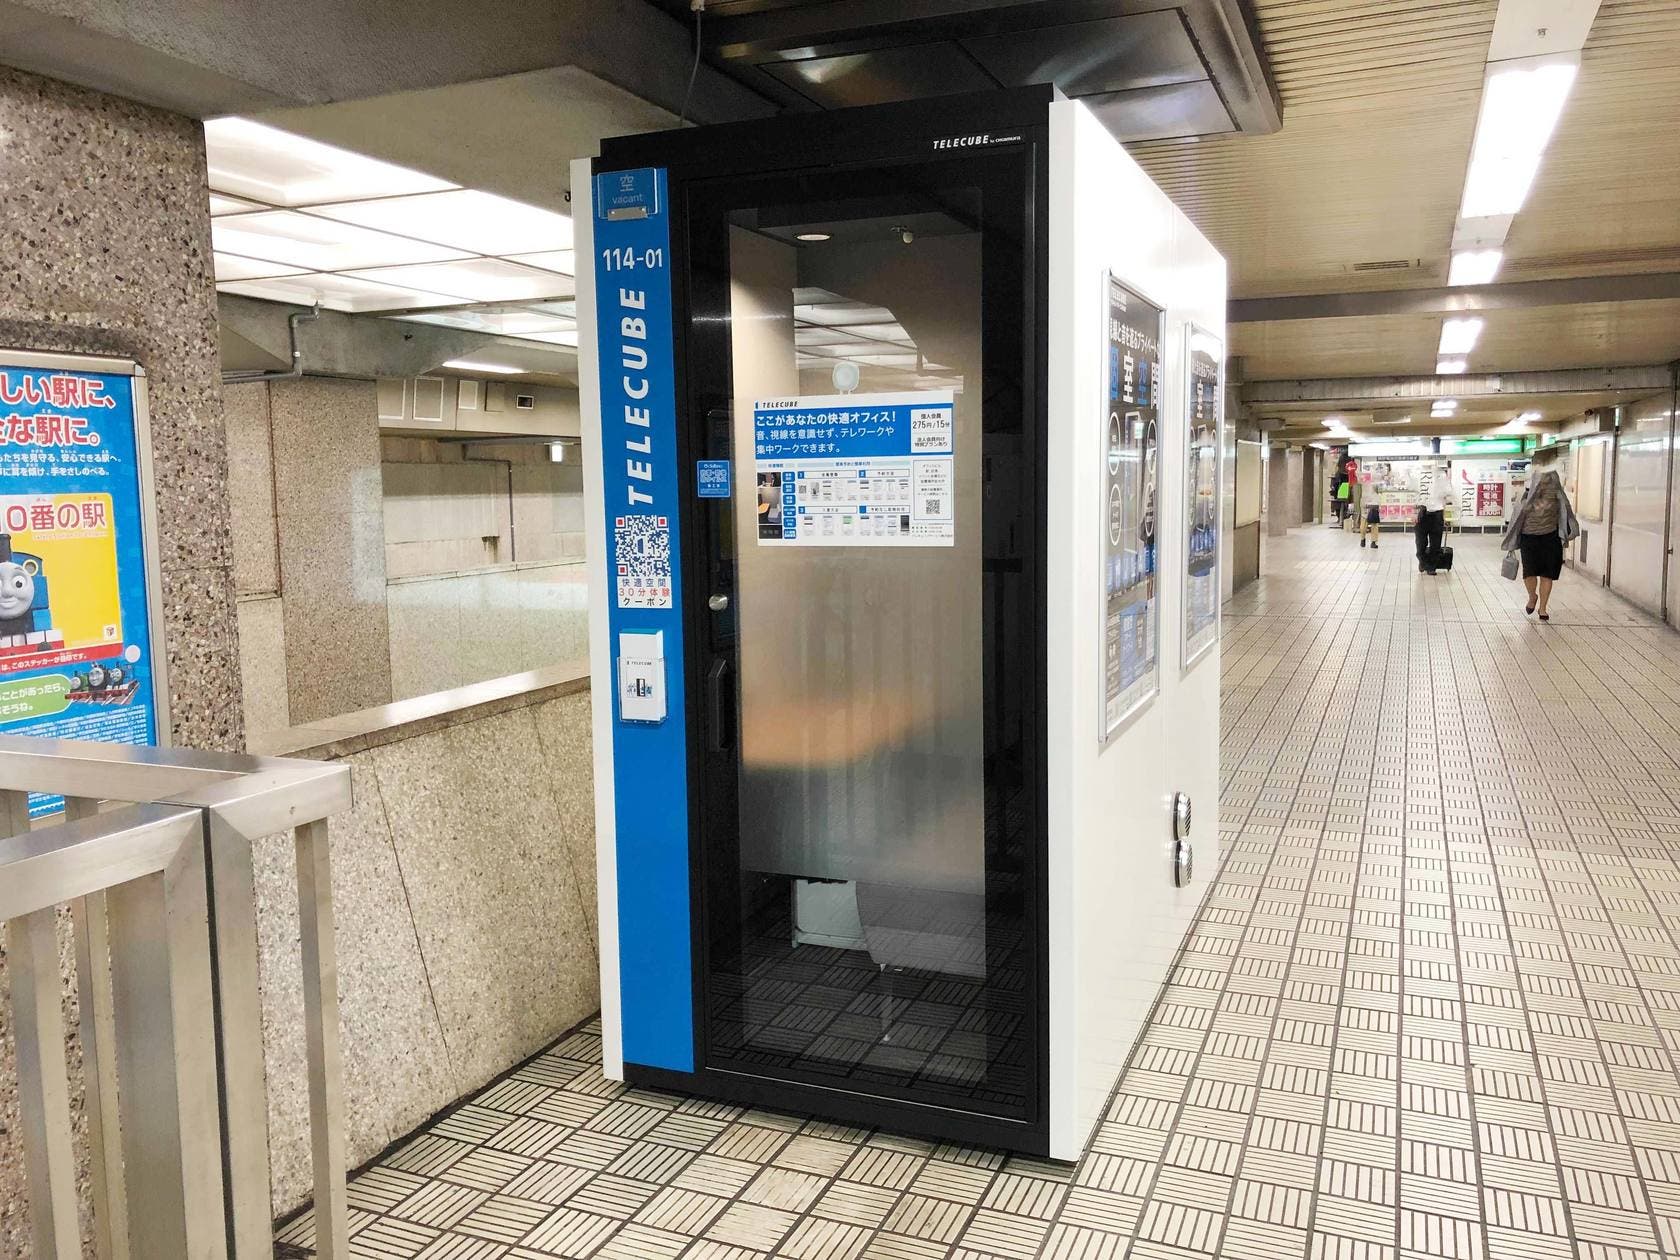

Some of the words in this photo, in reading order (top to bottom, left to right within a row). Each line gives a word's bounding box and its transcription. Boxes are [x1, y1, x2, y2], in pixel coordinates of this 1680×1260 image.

[933, 135, 989, 149] TELECUBE
[620, 174, 634, 192] 空
[612, 193, 643, 204] vacant
[602, 247, 662, 271] 114-01
[619, 287, 653, 506] TELECUBE
[756, 426, 895, 441] 音、視線を意識せず、テレワークや
[756, 443, 841, 454] 集中ワークできます。
[0, 503, 106, 533] 0番の駅
[0, 683, 66, 701] ことがあったら、
